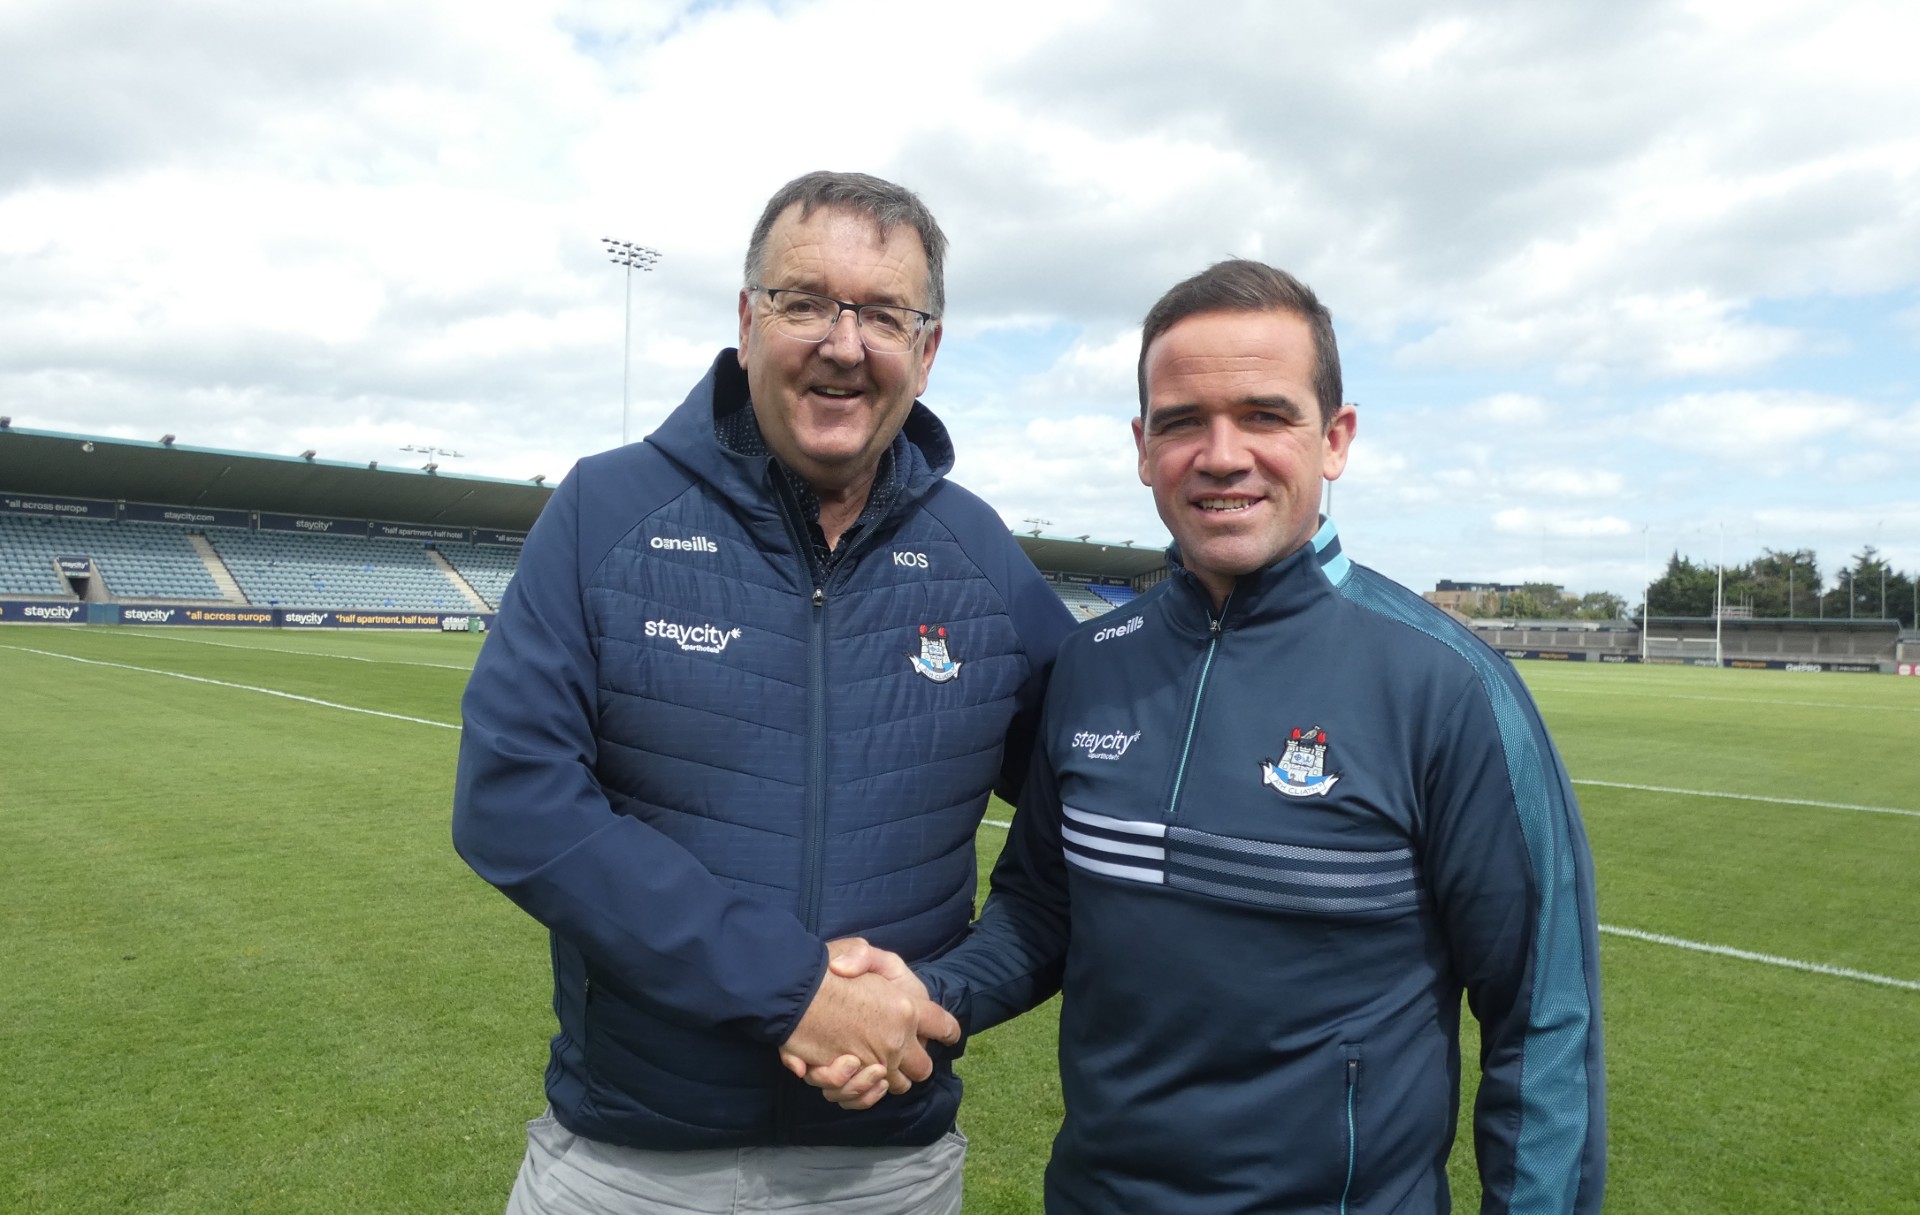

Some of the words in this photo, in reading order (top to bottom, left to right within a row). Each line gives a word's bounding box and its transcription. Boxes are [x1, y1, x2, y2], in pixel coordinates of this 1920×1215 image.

[22, 501, 54, 511] across
[55, 504, 88, 514] europe
[164, 511, 215, 522] staycity.com
[446, 531, 463, 539] hotel
[893, 551, 929, 568] KOS
[203, 612, 236, 621] across
[237, 613, 272, 624] europe
[401, 615, 417, 624] half
[417, 616, 438, 625] hotel
[681, 644, 720, 654] aparthotels
[1288, 785, 1319, 796] CLIATH
